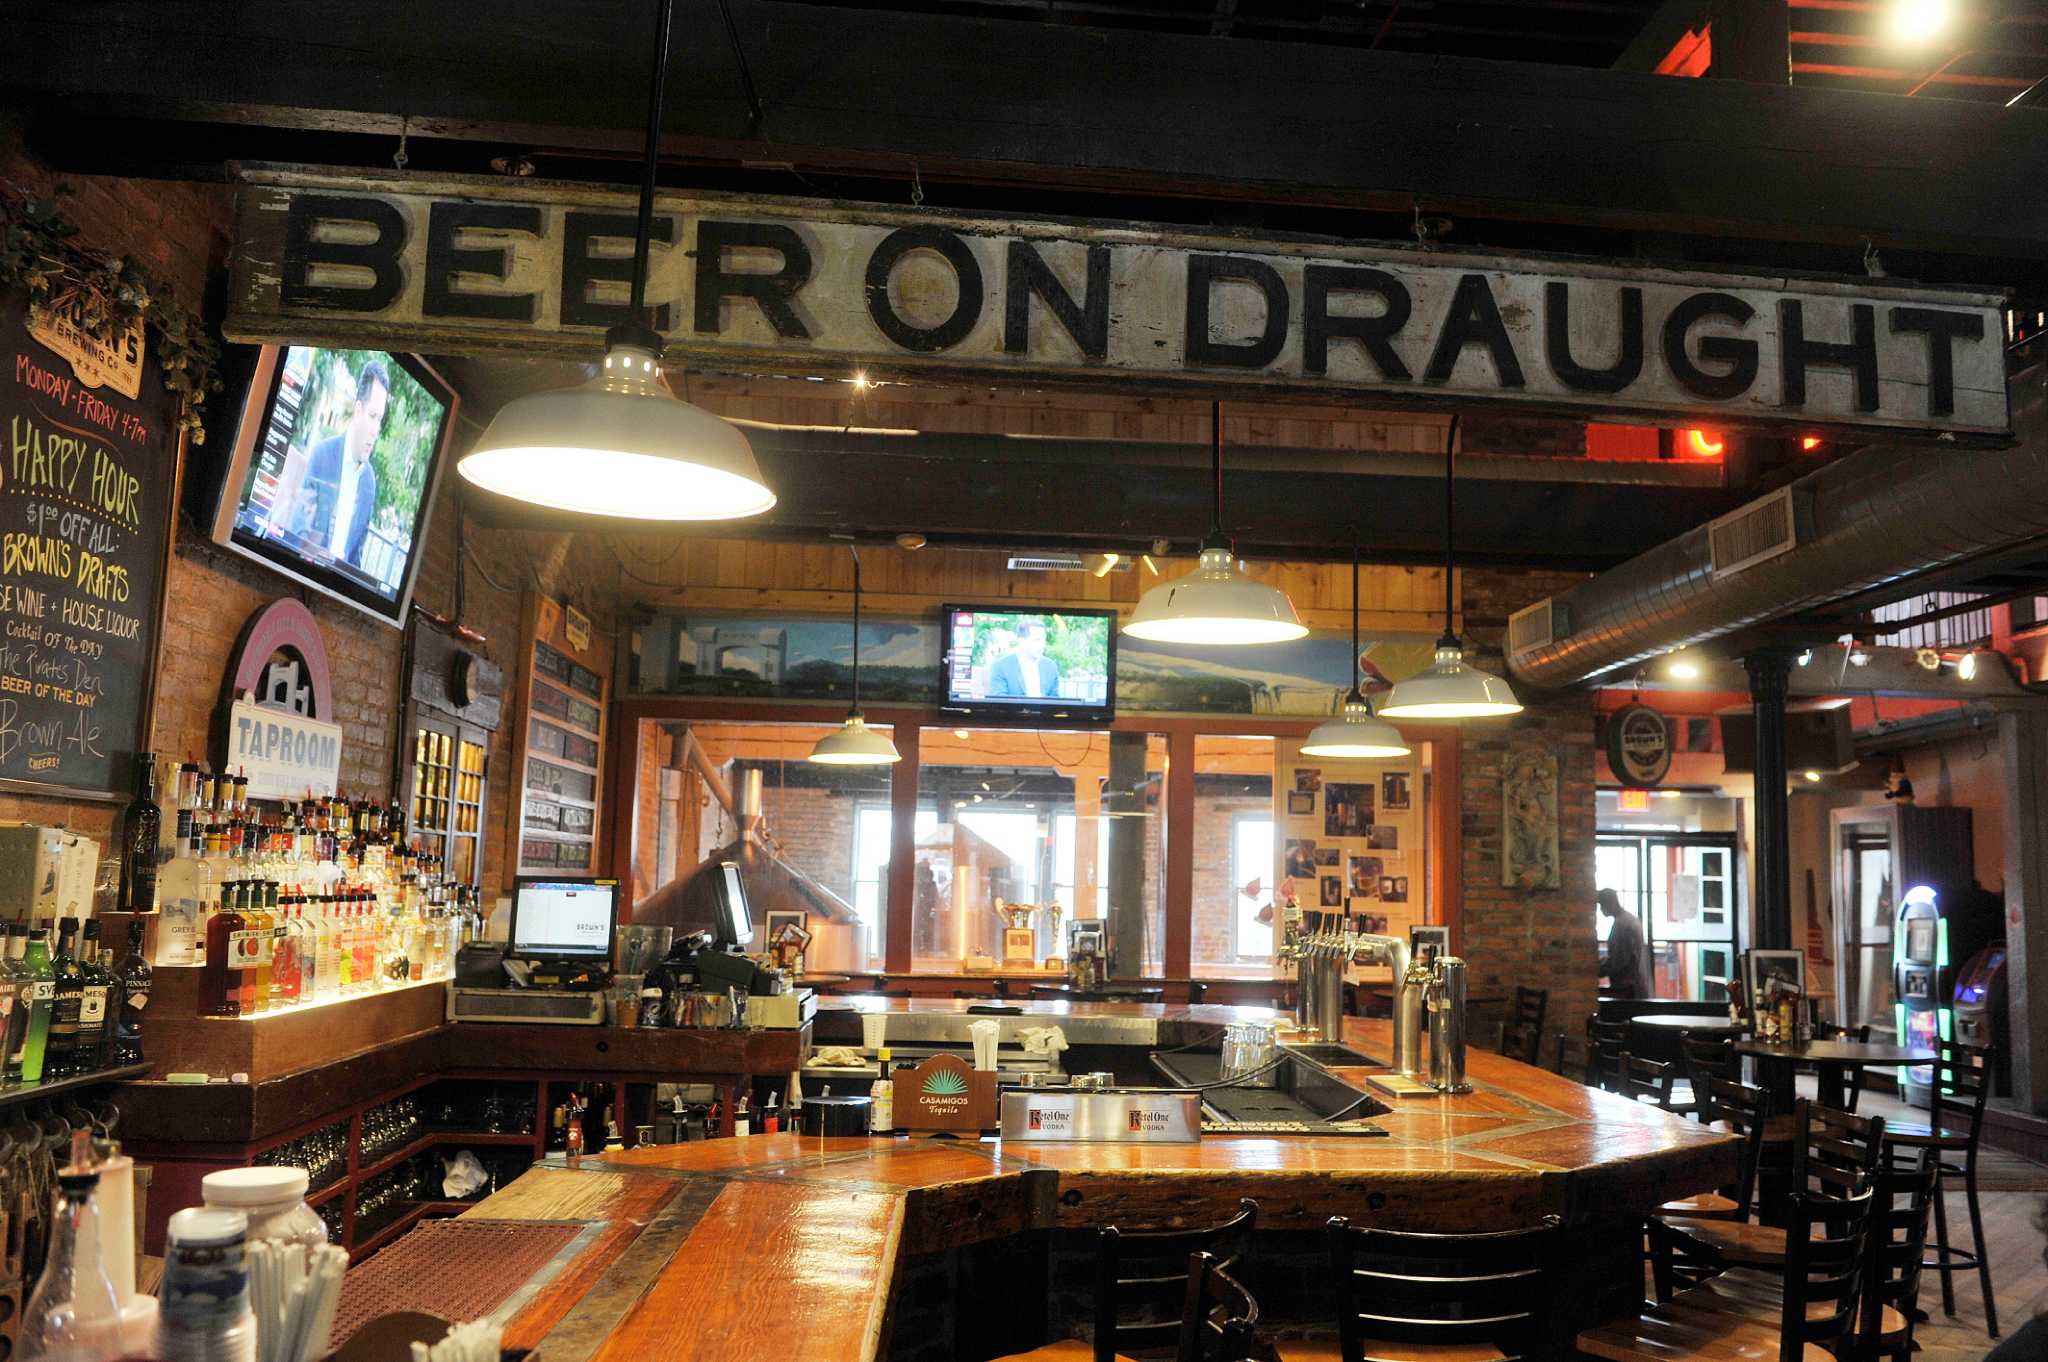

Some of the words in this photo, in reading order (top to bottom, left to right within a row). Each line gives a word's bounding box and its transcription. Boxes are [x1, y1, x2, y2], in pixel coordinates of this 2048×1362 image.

[279, 196, 814, 341] BEER
[864, 224, 1111, 363] ON
[1184, 253, 1985, 417] DRAUGHT
[57, 322, 104, 363] BREWING
[16, 352, 72, 406] MONDAY
[76, 389, 119, 431] FRIDAY
[11, 415, 88, 495] HAPPY
[91, 447, 140, 525] HOUR
[60, 511, 90, 545] OFF
[3, 532, 72, 579] BROWN'S
[76, 551, 129, 602] DRAFTS
[6, 620, 42, 641] Cocktail
[16, 587, 47, 618] WINE
[62, 597, 104, 632] HOUSE
[106, 609, 140, 641] LIQUOR
[1, 676, 32, 696] BEER
[35, 682, 50, 699] OF
[53, 686, 73, 705] THE
[76, 691, 97, 708] DAY
[0, 698, 63, 766] Brown
[238, 717, 336, 770] TAPROOM
[919, 1096, 969, 1105] CASAMIGOS
[929, 1105, 958, 1116] Tequila
[1029, 1109, 1053, 1128] Ketel
[1054, 1110, 1071, 1121] One
[1129, 1110, 1153, 1130] Ketel
